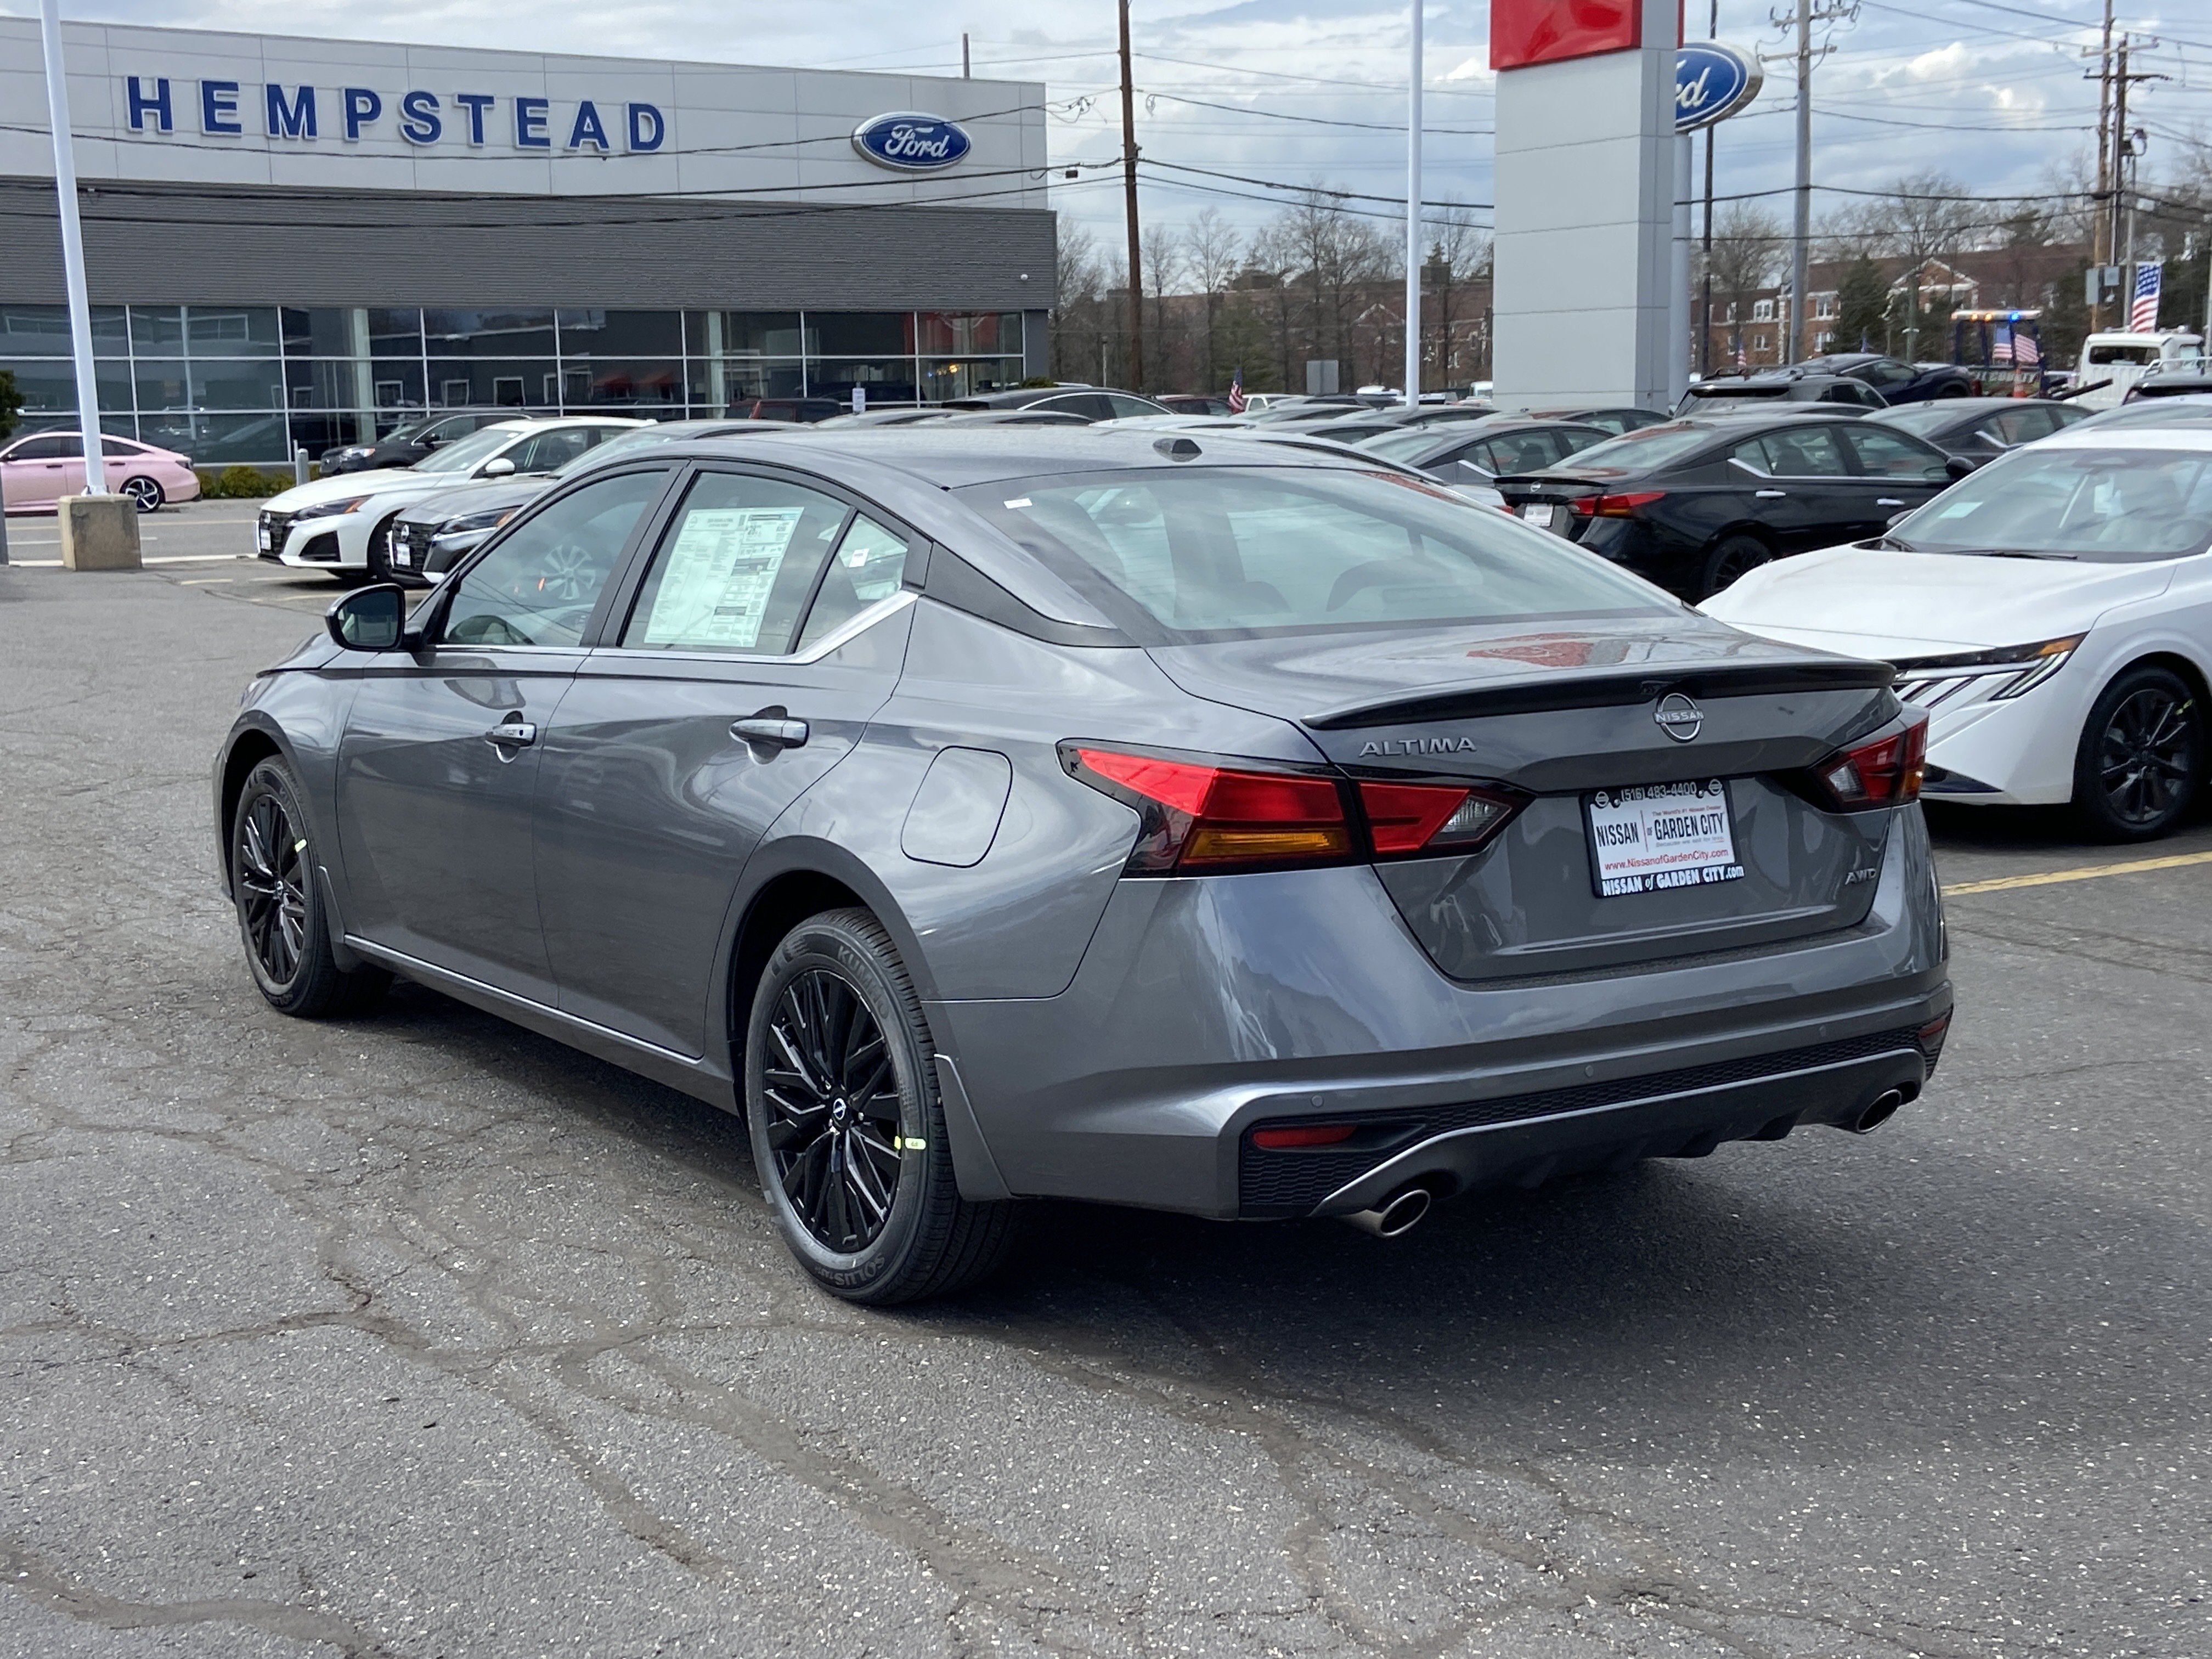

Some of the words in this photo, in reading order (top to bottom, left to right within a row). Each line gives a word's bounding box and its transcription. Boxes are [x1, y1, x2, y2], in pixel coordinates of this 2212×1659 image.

[126, 75, 665, 153] HEMPSTEAD
[884, 124, 950, 157] Ford
[1655, 711, 1704, 723] NISSAN
[1358, 737, 1477, 758] ALTIMA
[1620, 787, 1645, 802] (516)
[1647, 781, 1697, 799] 483-4400
[1596, 822, 1640, 847] NISSAN
[1654, 815, 1700, 840] GARDEN
[1700, 812, 1725, 835] CITY
[1605, 849, 1729, 871] www.NissanofGardenCity.com
[1602, 878, 1643, 896] NISSAN
[1645, 874, 1655, 890] of
[1656, 868, 1700, 889] GARDEN
[1702, 865, 1745, 883] CITY.com
[1845, 868, 1876, 885] AWD
[834, 1252, 885, 1286] SOLUS
